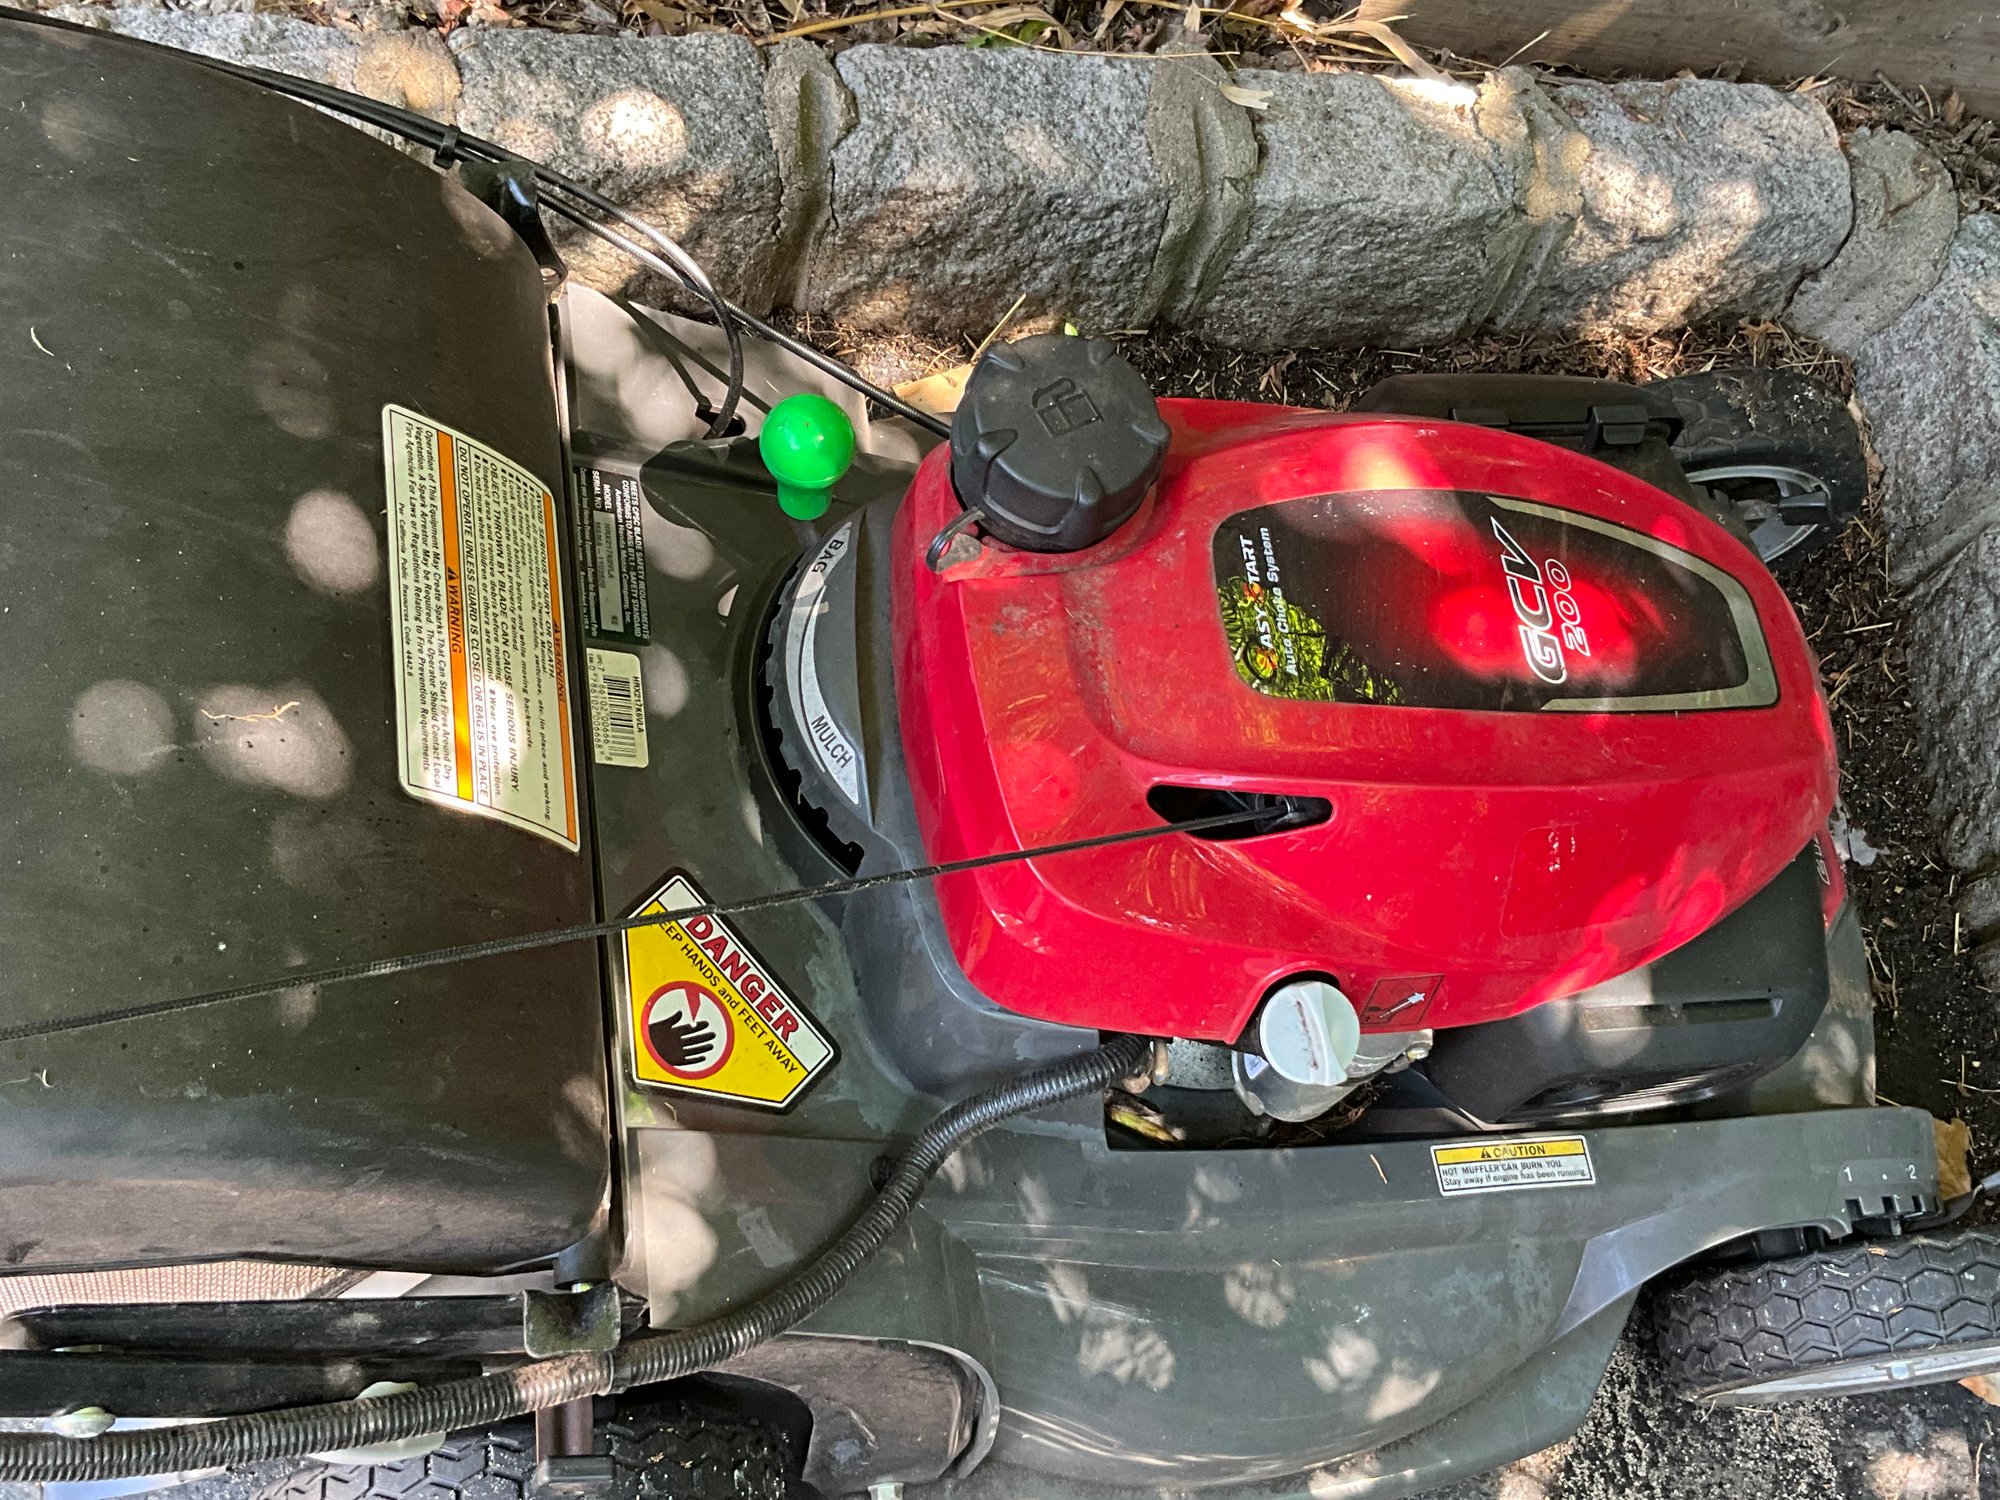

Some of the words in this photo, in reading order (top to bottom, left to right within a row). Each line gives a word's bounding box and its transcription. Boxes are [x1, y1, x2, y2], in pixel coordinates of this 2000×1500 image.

[405, 421, 413, 438] Fire
[404, 438, 415, 477] Agencies
[424, 430, 434, 471] Operation
[458, 446, 467, 462] DO
[418, 473, 426, 481] A
[427, 472, 436, 483] of
[460, 464, 469, 488] NOT
[473, 460, 481, 473] Do
[481, 464, 490, 498] Inspect
[500, 475, 507, 487] Do
[408, 479, 416, 494] For
[417, 483, 427, 508] Spark
[428, 484, 436, 501] This
[474, 475, 482, 491] not
[489, 462, 500, 507] OBJECT
[591, 470, 600, 494] SERIAL
[629, 480, 638, 505] MEETS
[409, 496, 417, 518] Laws
[461, 489, 472, 537] OPERATE
[535, 490, 543, 524] AVOID
[614, 488, 623, 523] American
[621, 479, 632, 519] CONFORMS
[410, 520, 417, 530] or
[420, 509, 428, 547] Arrestor
[428, 503, 439, 549] Equipment
[502, 506, 510, 541] operate
[625, 519, 632, 529] TO
[631, 506, 640, 526] CPSC
[486, 522, 494, 541] and
[493, 509, 503, 558] THROWN
[617, 524, 625, 548] Honda
[633, 526, 642, 550] BLADE
[410, 532, 421, 583] Regulations
[420, 548, 431, 567] May
[430, 550, 440, 570] May
[464, 539, 475, 581] UNLESS
[479, 542, 487, 580] children
[505, 543, 513, 572] unless
[538, 526, 547, 574] SERIOUS
[812, 539, 844, 573] BAG
[1260, 528, 1280, 583] System
[400, 556, 408, 580] Public
[422, 569, 431, 580] be
[496, 560, 505, 577] BY
[635, 551, 644, 580] SAFETY
[433, 572, 441, 601] Create
[481, 582, 487, 593] or
[489, 579, 498, 609] debris
[497, 579, 507, 618] BLADE
[506, 574, 516, 614] properly
[542, 576, 550, 617] INJURY
[629, 570, 638, 598] SAFETY
[413, 585, 423, 622] Relating
[422, 582, 434, 624] Required.
[467, 584, 477, 622] GUARD
[482, 595, 490, 625] others
[638, 580, 649, 639] REQUIREMENTS
[1273, 587, 1289, 633] Choke
[1490, 516, 1567, 684] GCV
[1545, 559, 1590, 657] 200
[415, 624, 422, 634] to
[433, 603, 443, 634] Sparks
[448, 584, 461, 653] WARNING
[469, 623, 478, 635] IS
[491, 611, 499, 642] before
[545, 620, 551, 637] OR
[631, 598, 641, 637] STANDARD
[416, 636, 424, 654] Fire
[426, 629, 434, 645] The
[437, 638, 445, 657] That
[500, 621, 509, 646] CAN
[426, 647, 436, 688] Operator
[438, 659, 446, 677] Can
[470, 637, 481, 682] CLOSED
[502, 649, 512, 689] CAUSE
[554, 637, 564, 702] WARNING
[1283, 638, 1298, 676] Auto
[417, 656, 427, 705] Prevention
[439, 680, 447, 702] Start
[473, 685, 482, 701] OR
[589, 677, 599, 710] 786102
[429, 690, 438, 721] Should
[599, 683, 608, 711] 86102
[632, 675, 644, 732] HRX217K6VLA
[439, 703, 448, 727] Fires
[474, 704, 484, 727] BAG
[505, 692, 516, 744] SERIOUS
[601, 715, 610, 744] 00666
[419, 707, 430, 772] Requirements.
[431, 723, 440, 760] Contact
[442, 728, 451, 762] Around
[476, 730, 484, 741] IS
[592, 714, 602, 748] 006668
[811, 715, 853, 768] MULCH
[477, 744, 485, 756] IN
[432, 761, 443, 788] Local
[442, 764, 451, 780] Dry
[478, 759, 488, 797] PLACE
[509, 747, 519, 792] INJURY.
[685, 914, 799, 1043] DANGER
[681, 943, 720, 987] HANDS
[718, 985, 739, 1009] and
[738, 1006, 767, 1038] FEET
[764, 1039, 798, 1074] AWAY
[1493, 1145, 1546, 1158] CAUTION
[1442, 1167, 1457, 1176] HOT
[1462, 1163, 1500, 1174] MUFFLER
[1501, 1163, 1518, 1172] CAN
[1521, 1161, 1543, 1169] BURN
[1444, 1178, 1461, 1186] Stay
[1464, 1175, 1483, 1185] away
[1485, 1173, 1491, 1182] if
[1493, 1174, 1518, 1184] engine
[1520, 1171, 1535, 1179] has
[1537, 1169, 1556, 1178] been
[1557, 1168, 1587, 1178] running.
[1844, 1166, 1852, 1182] 1
[1908, 1165, 1917, 1179] 2
